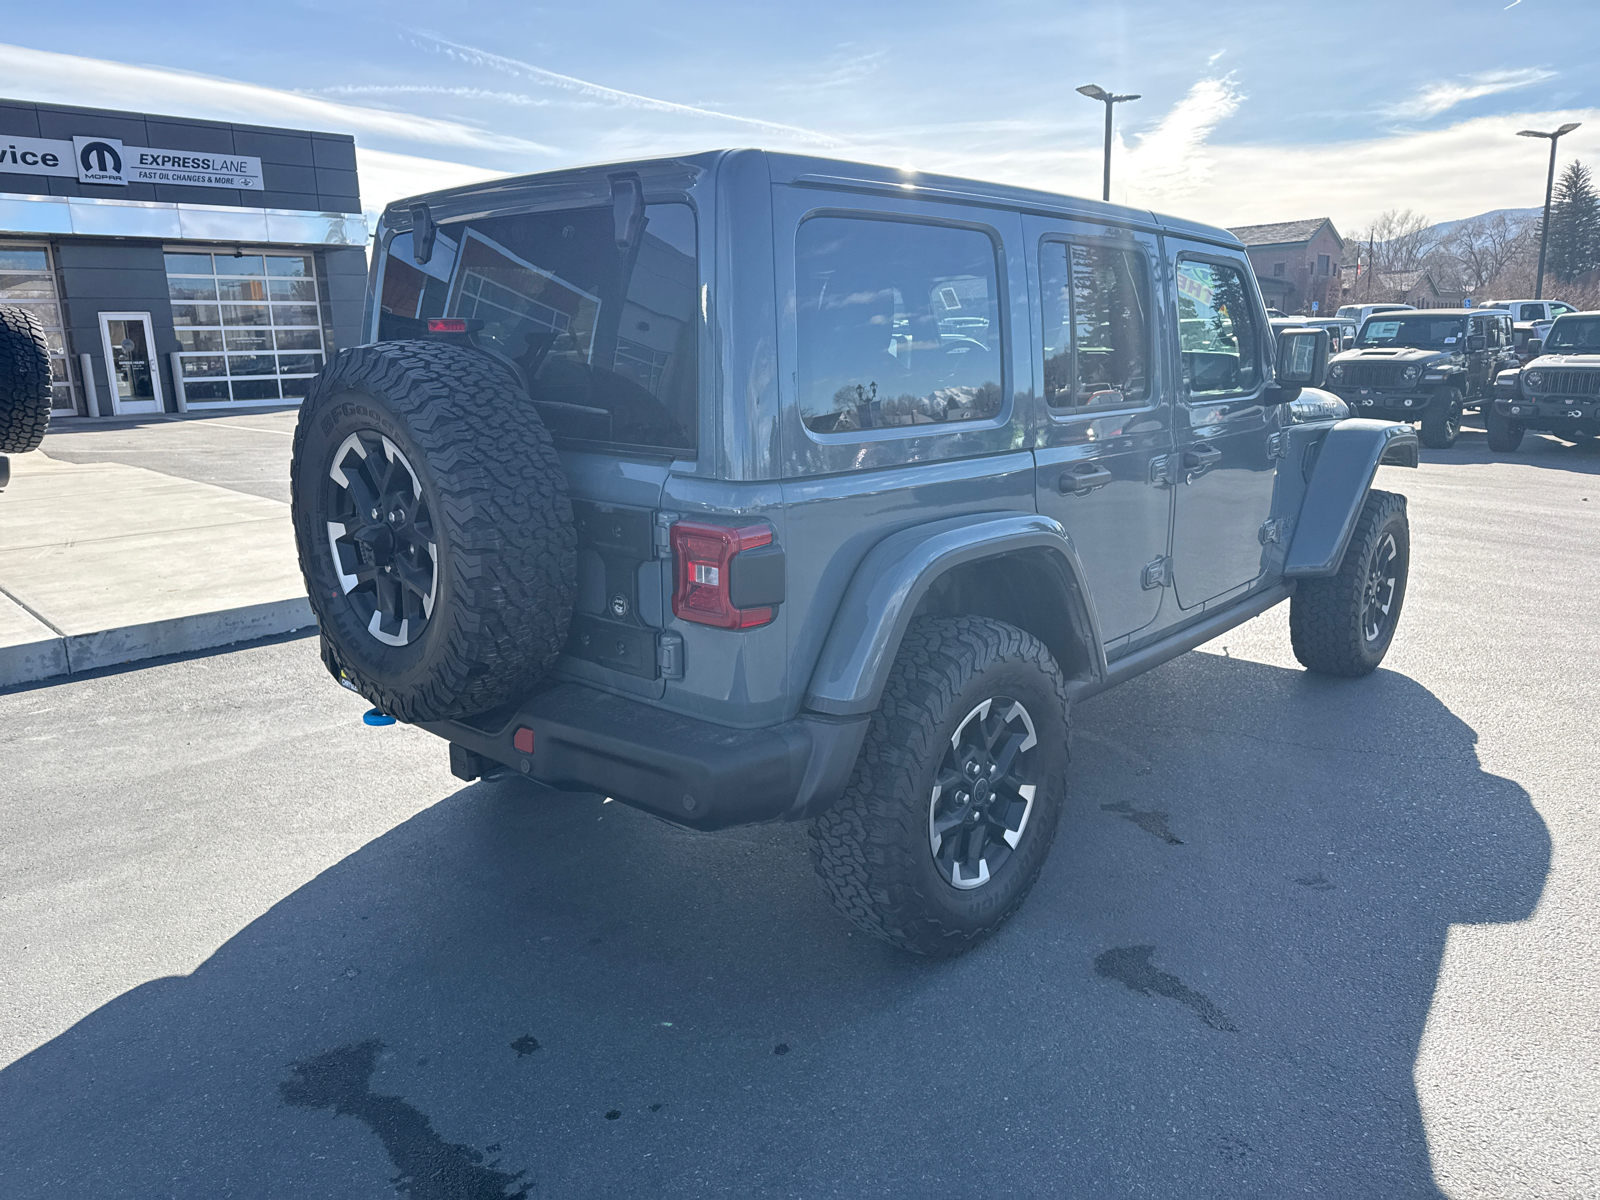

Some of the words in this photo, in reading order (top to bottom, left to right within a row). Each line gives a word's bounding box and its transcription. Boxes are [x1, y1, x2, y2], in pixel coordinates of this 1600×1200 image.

[139, 153, 248, 173] EXPRESSLANE
[84, 173, 123, 181] MOPAR
[138, 171, 157, 179] FAST
[159, 172, 170, 180] OIL
[171, 173, 206, 183] CHANGES
[214, 177, 235, 185] MORE
